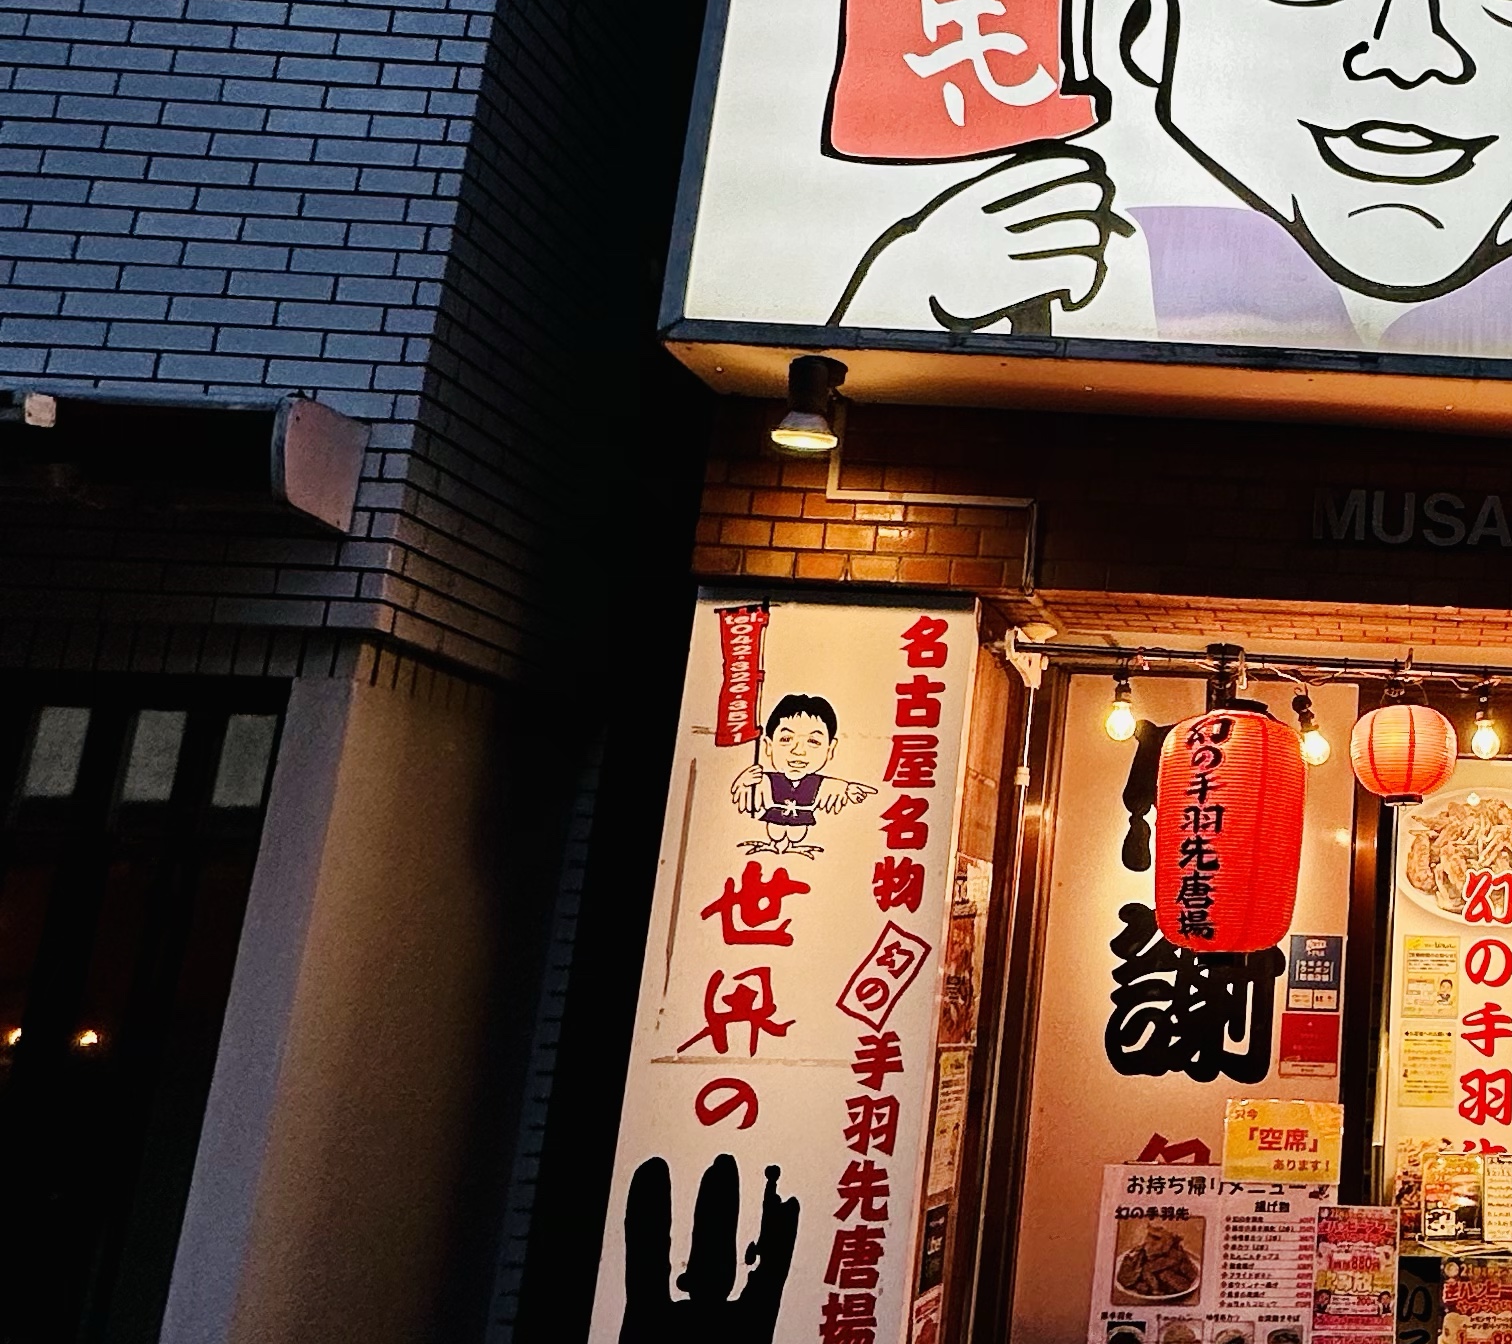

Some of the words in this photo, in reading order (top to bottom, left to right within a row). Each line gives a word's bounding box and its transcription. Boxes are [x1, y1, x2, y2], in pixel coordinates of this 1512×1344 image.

[871, 615, 949, 914] 名古屋名物
[676, 860, 811, 1130] 世界の
